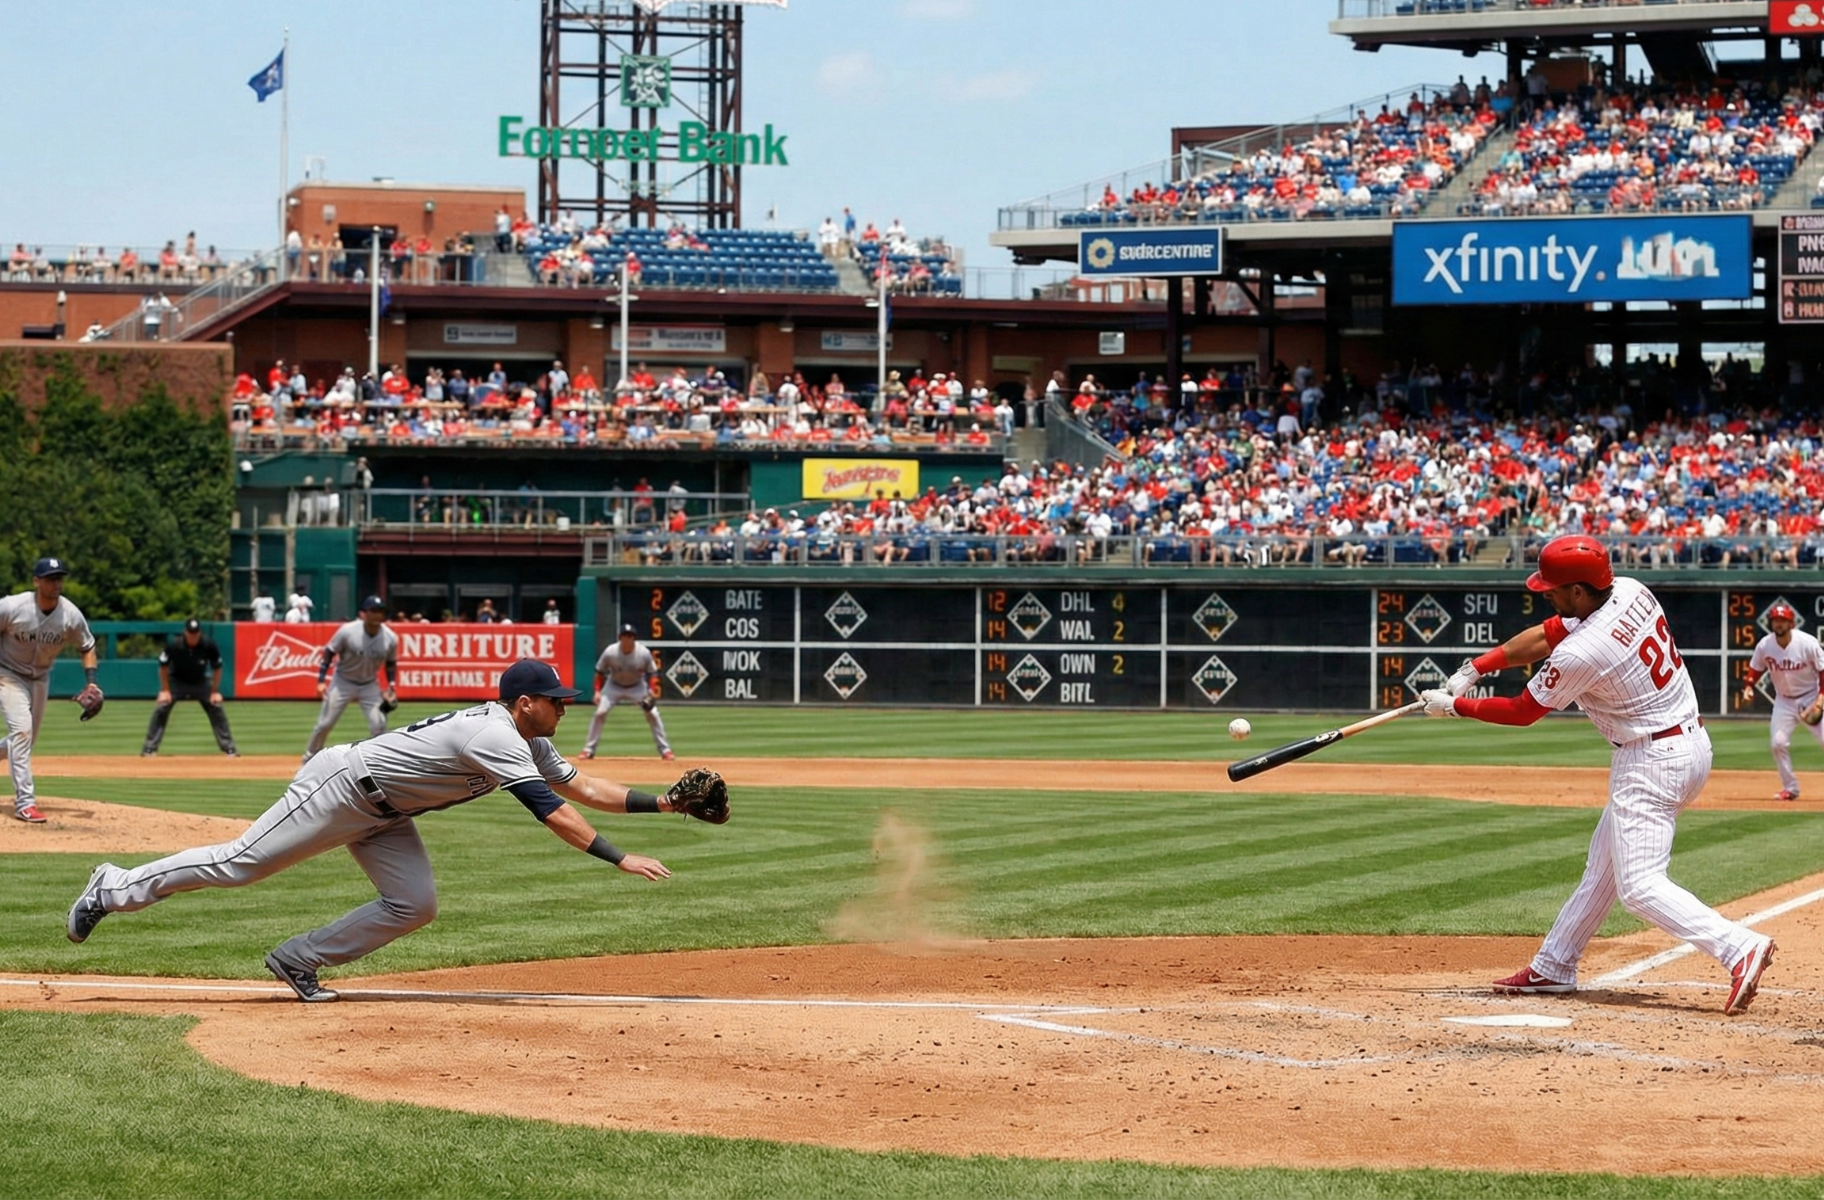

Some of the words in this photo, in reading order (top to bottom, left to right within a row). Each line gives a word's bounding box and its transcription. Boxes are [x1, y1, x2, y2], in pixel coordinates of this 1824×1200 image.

[679, 121, 789, 165] Bank
[651, 589, 662, 610] 2
[988, 591, 1006, 612] 12
[1061, 592, 1095, 612] DHL
[1378, 593, 1403, 614] 24
[1464, 594, 1498, 615] SFU
[1522, 594, 1534, 614] 3
[1729, 594, 1754, 616] 25
[725, 617, 759, 638] COS
[988, 620, 1006, 640] 14
[1112, 620, 1125, 641] 2
[1378, 622, 1403, 642] 23
[1464, 622, 1499, 643] DEL
[1735, 624, 1754, 646] 15
[988, 653, 1006, 673] 14
[1060, 653, 1095, 674] OWN
[1112, 654, 1125, 674] 2
[1382, 656, 1403, 677] 14
[725, 678, 758, 699] BAL
[988, 682, 1006, 701] 14
